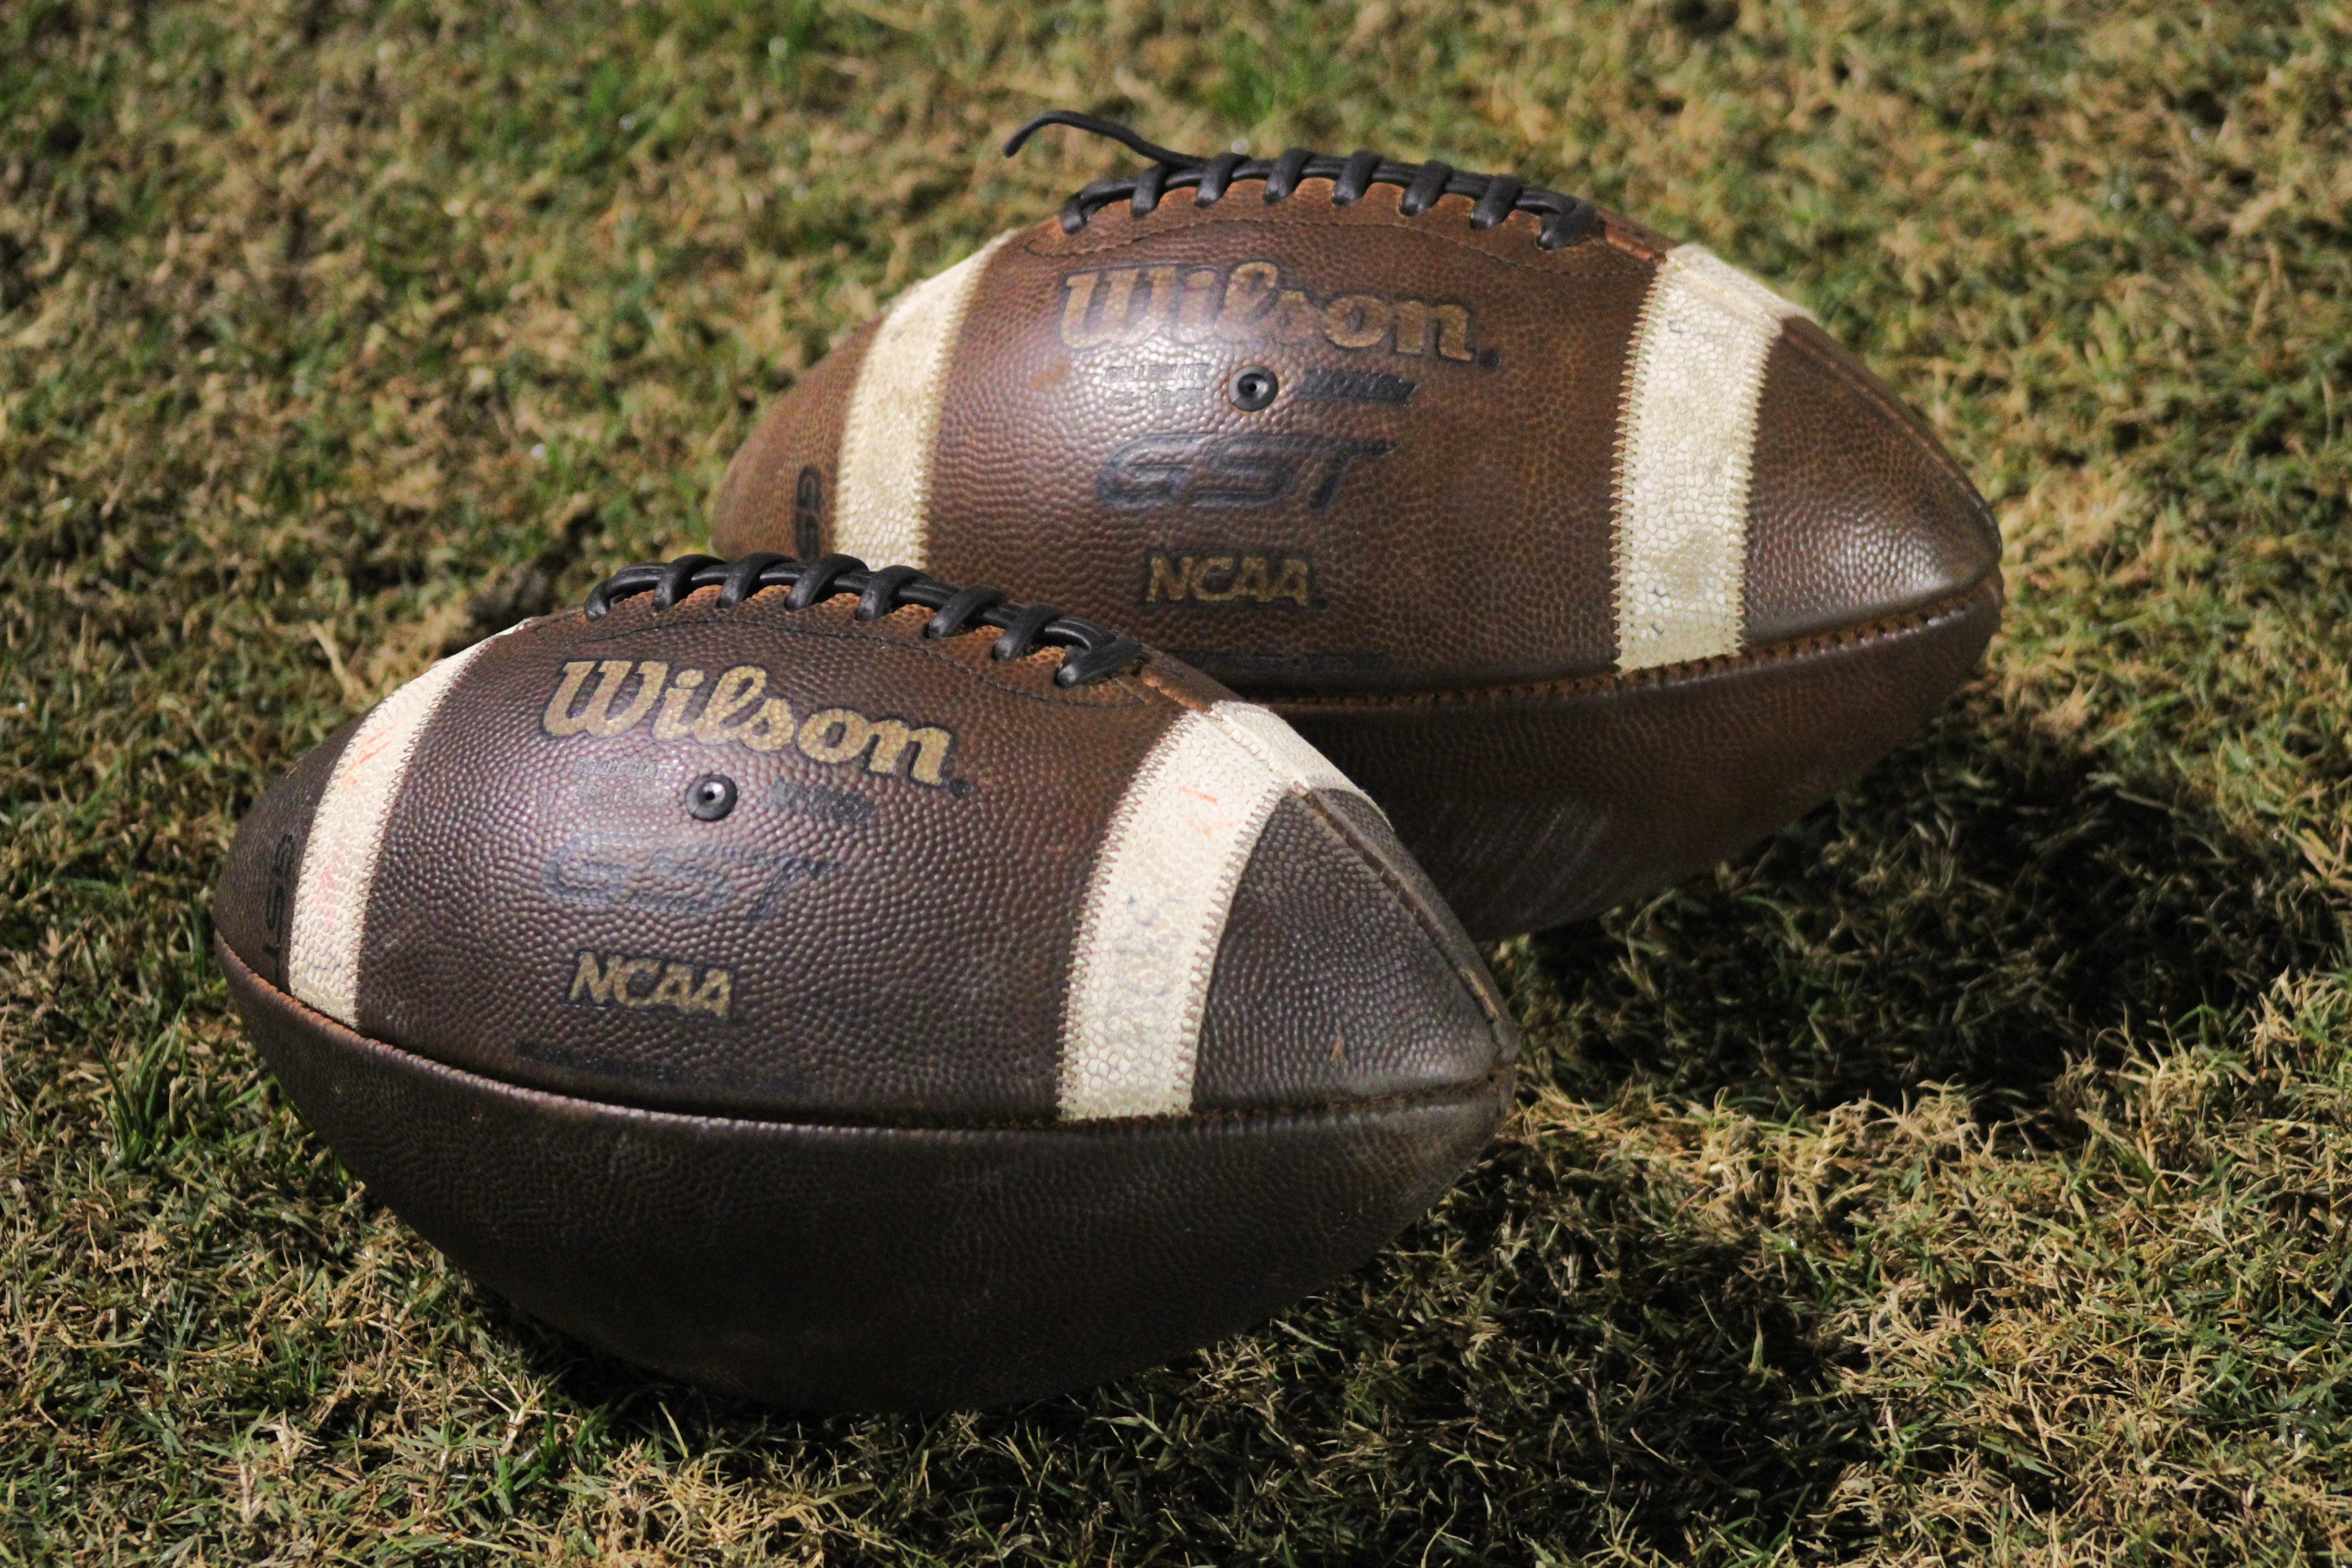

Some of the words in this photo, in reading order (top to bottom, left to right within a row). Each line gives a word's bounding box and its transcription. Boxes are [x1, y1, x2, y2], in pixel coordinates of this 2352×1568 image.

[1057, 259, 1478, 363] Wilson
[1144, 555, 1312, 608] NCAA
[541, 659, 955, 786] Wilson
[566, 950, 736, 1020] NCAA
